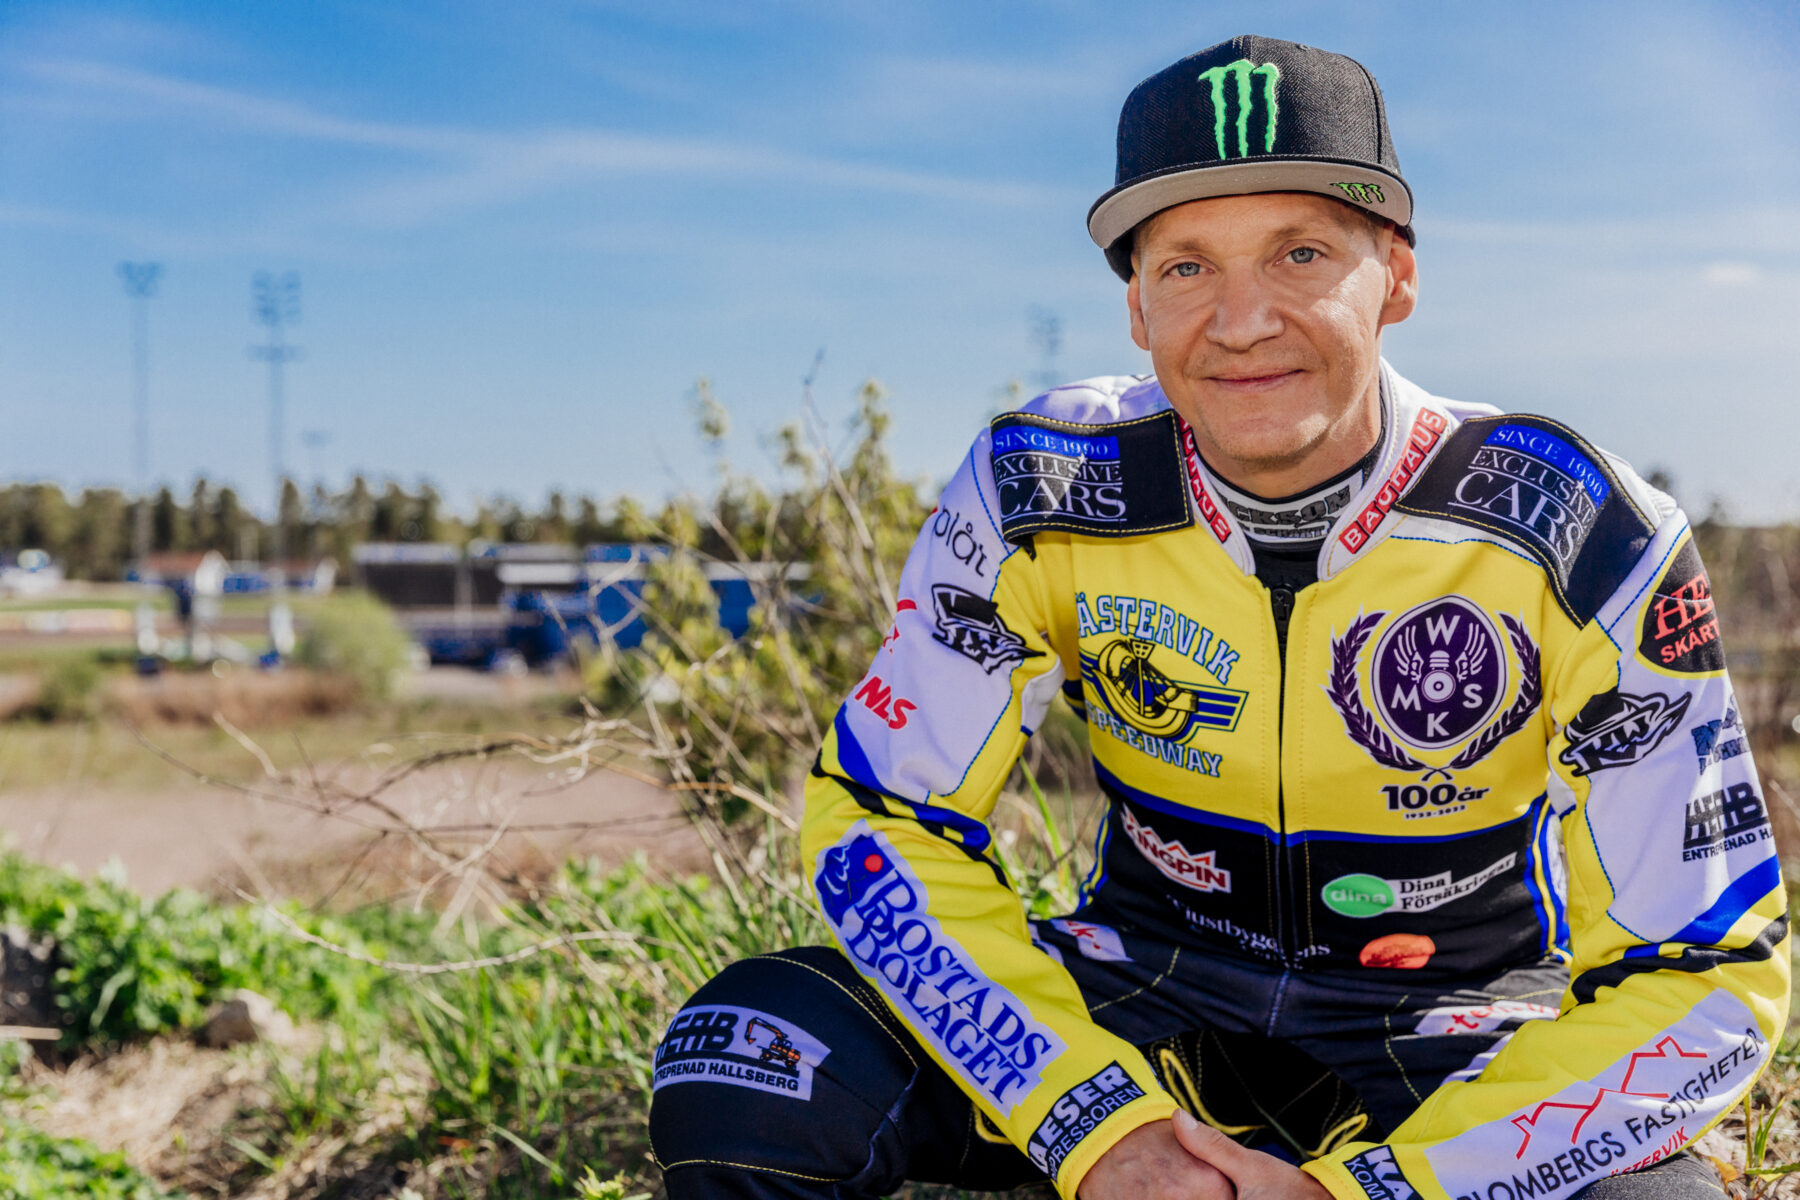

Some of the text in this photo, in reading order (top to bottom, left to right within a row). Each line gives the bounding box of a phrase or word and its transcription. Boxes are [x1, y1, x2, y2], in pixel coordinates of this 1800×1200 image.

[995, 434, 1056, 448] SINCE
[995, 456, 1122, 481] EXCLUSIVE
[1494, 430, 1603, 496] SINCE 1990
[1000, 477, 1126, 518] CARS
[1342, 410, 1444, 551] BAUHAUS
[1471, 450, 1593, 523] EXCLUSIVE
[1455, 471, 1581, 561] CARS
[1075, 592, 1240, 685] ÄSTERVIK
[1085, 699, 1222, 777] SPEEDWAY
[1127, 824, 1225, 888] INGPIN
[1400, 878, 1445, 893] Dina
[1331, 889, 1386, 905] dina
[854, 869, 1052, 1070] BOSTADS
[846, 904, 1026, 1104] BOLAGET
[709, 1063, 798, 1091] HALLSBERG
[1625, 1027, 1764, 1145] FASTIGHETER
[1346, 1157, 1391, 1200] KOM
